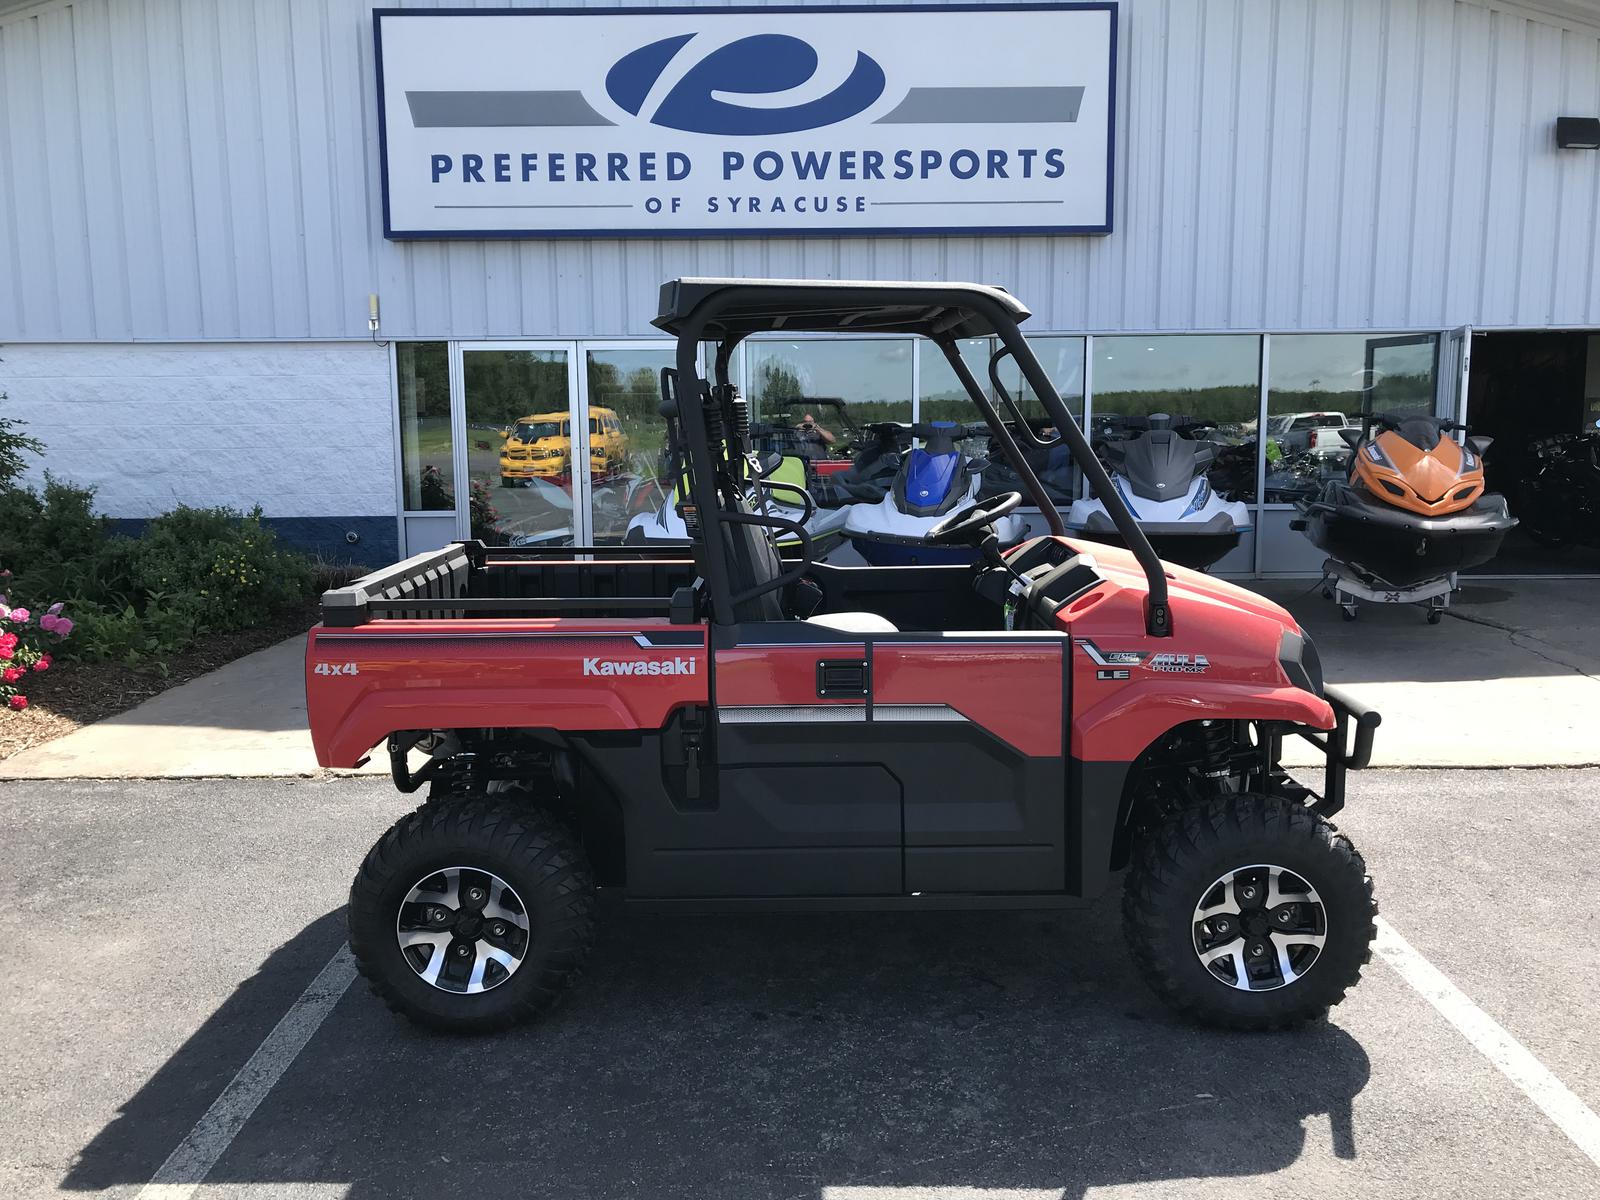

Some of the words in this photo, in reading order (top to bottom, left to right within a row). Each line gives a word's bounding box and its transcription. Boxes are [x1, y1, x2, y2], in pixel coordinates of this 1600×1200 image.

[431, 152, 692, 183] PREFERRED
[723, 148, 1065, 182] POWERSPORTS
[645, 197, 681, 214] OF
[707, 196, 866, 213] SYRACUSE
[314, 662, 359, 676] 4x4
[583, 656, 696, 676] Kawasaki
[1098, 670, 1130, 680] LE
